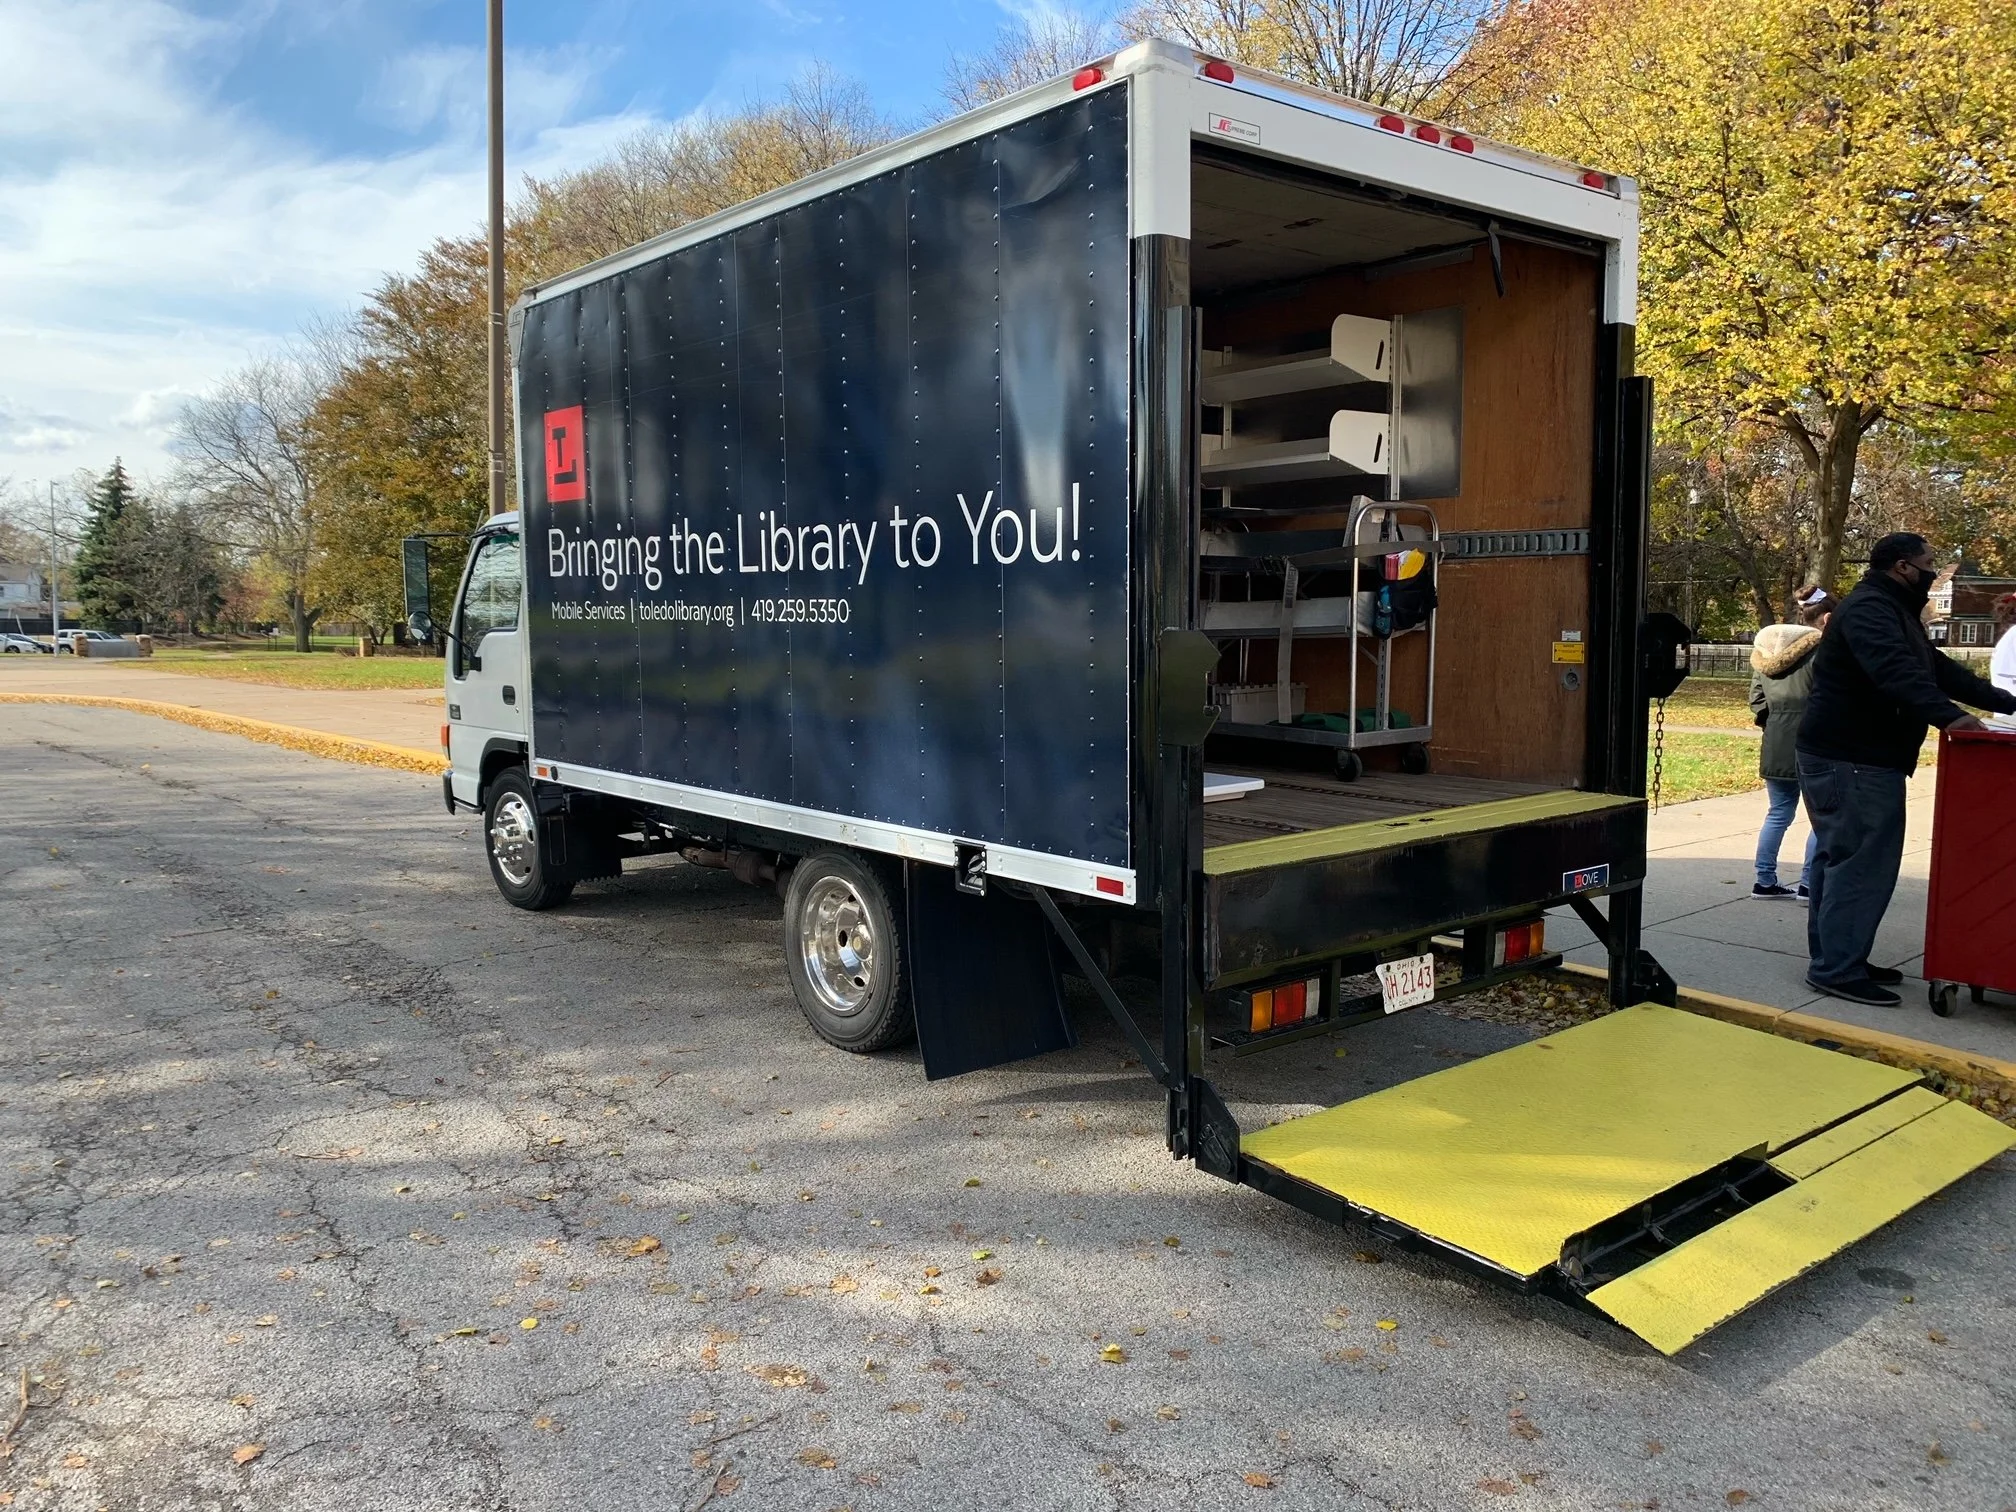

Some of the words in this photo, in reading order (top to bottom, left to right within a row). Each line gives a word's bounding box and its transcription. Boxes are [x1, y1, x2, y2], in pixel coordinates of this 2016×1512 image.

[548, 523, 662, 591] Bringing
[669, 517, 725, 575] the
[737, 510, 877, 585] Library
[889, 505, 941, 568] to
[956, 482, 1080, 565] You!
[551, 601, 583, 620] Mobile
[584, 601, 625, 620] Services
[639, 600, 734, 627] toledolibrary.org
[751, 598, 849, 623] 419.259.5350
[1397, 961, 1415, 970] OHIO
[1401, 966, 1432, 995] 2143
